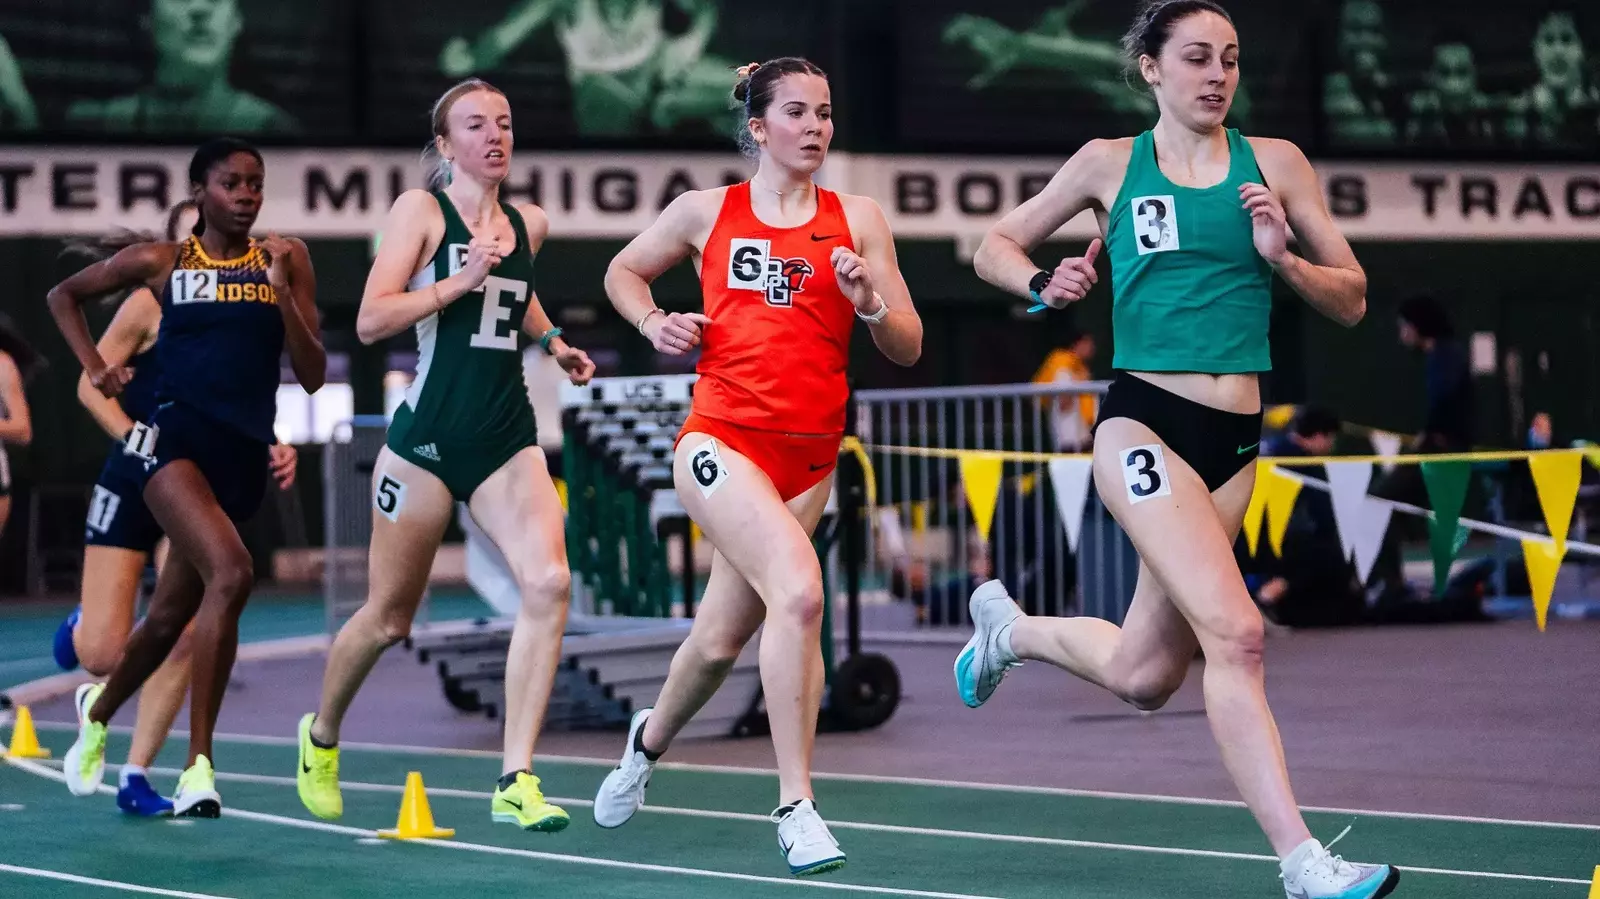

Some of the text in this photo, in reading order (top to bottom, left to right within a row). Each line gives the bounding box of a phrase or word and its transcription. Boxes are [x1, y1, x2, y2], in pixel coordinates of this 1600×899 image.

[0, 164, 170, 213] TER
[304, 166, 747, 213] MIHIGA
[1137, 199, 1170, 249] 3
[732, 246, 762, 282] 6
[175, 271, 210, 301] 12
[469, 275, 528, 351] E
[692, 450, 718, 487] 6
[1126, 448, 1161, 497] 3
[377, 475, 401, 513] 5
